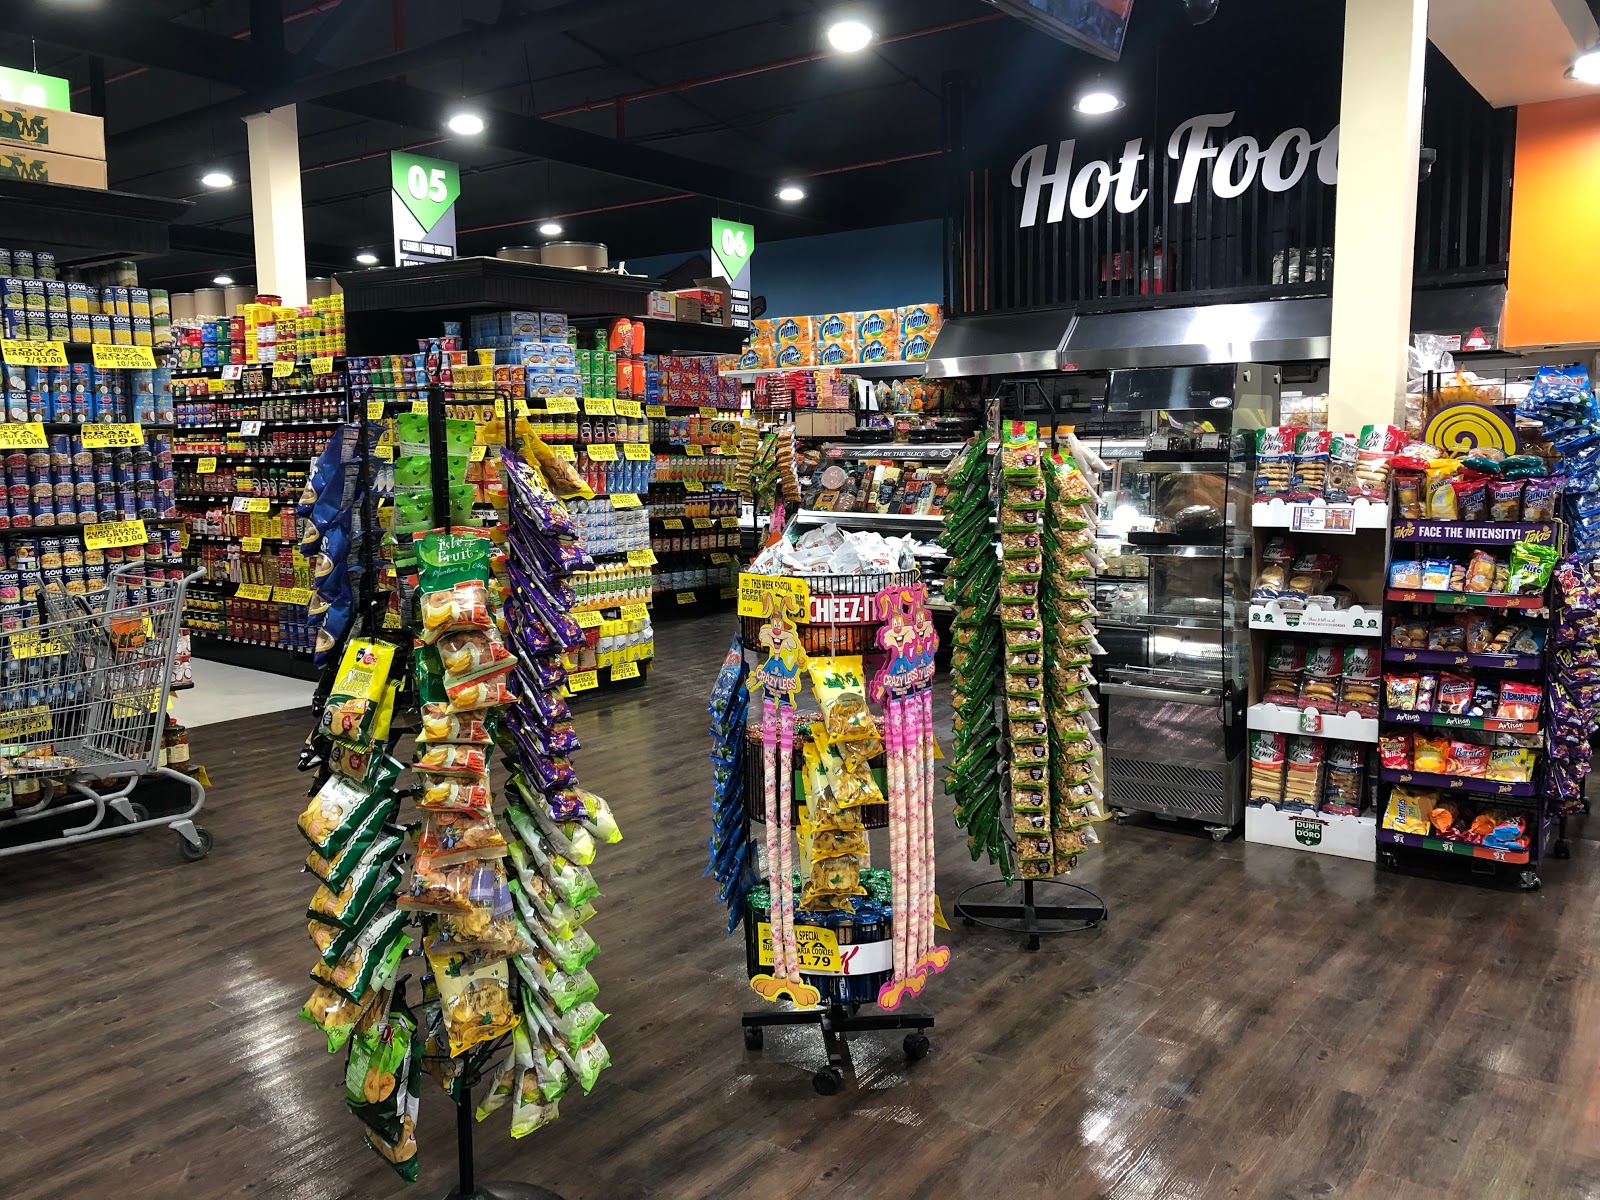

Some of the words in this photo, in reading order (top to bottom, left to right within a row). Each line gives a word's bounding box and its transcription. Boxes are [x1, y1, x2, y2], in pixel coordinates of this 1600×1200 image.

[407, 165, 447, 203] 05
[1011, 137, 1149, 228] Hot
[721, 228, 747, 258] 06
[24, 280, 43, 288] GOYA
[25, 356, 63, 364] 2/$3.00
[5, 438, 43, 446] 3/$5.00
[1394, 522, 1415, 539] Takis
[1418, 526, 1442, 538] FACE
[1444, 527, 1463, 538] THE
[1465, 528, 1521, 540] INTENSITY!
[1525, 526, 1552, 543] Takis
[438, 534, 462, 551] Isle
[438, 548, 473, 563] Fruit
[751, 578, 761, 589] THIS
[761, 579, 773, 591] WEEK
[756, 668, 780, 688] CRAZY
[778, 676, 797, 691] LEGS
[883, 673, 903, 688] CRAZY
[902, 667, 919, 684] LEGS
[1396, 713, 1420, 722] Artisan
[1446, 717, 1471, 726] Artisan
[1498, 721, 1523, 730] Artisan
[1492, 749, 1521, 760] Barritas
[1296, 821, 1320, 831] DUNK
[1296, 830, 1320, 839] D'ORO
[799, 930, 820, 941] SPECIAL
[762, 938, 828, 950] GYA
[811, 947, 834, 957] COOKIES
[836, 945, 860, 975] K
